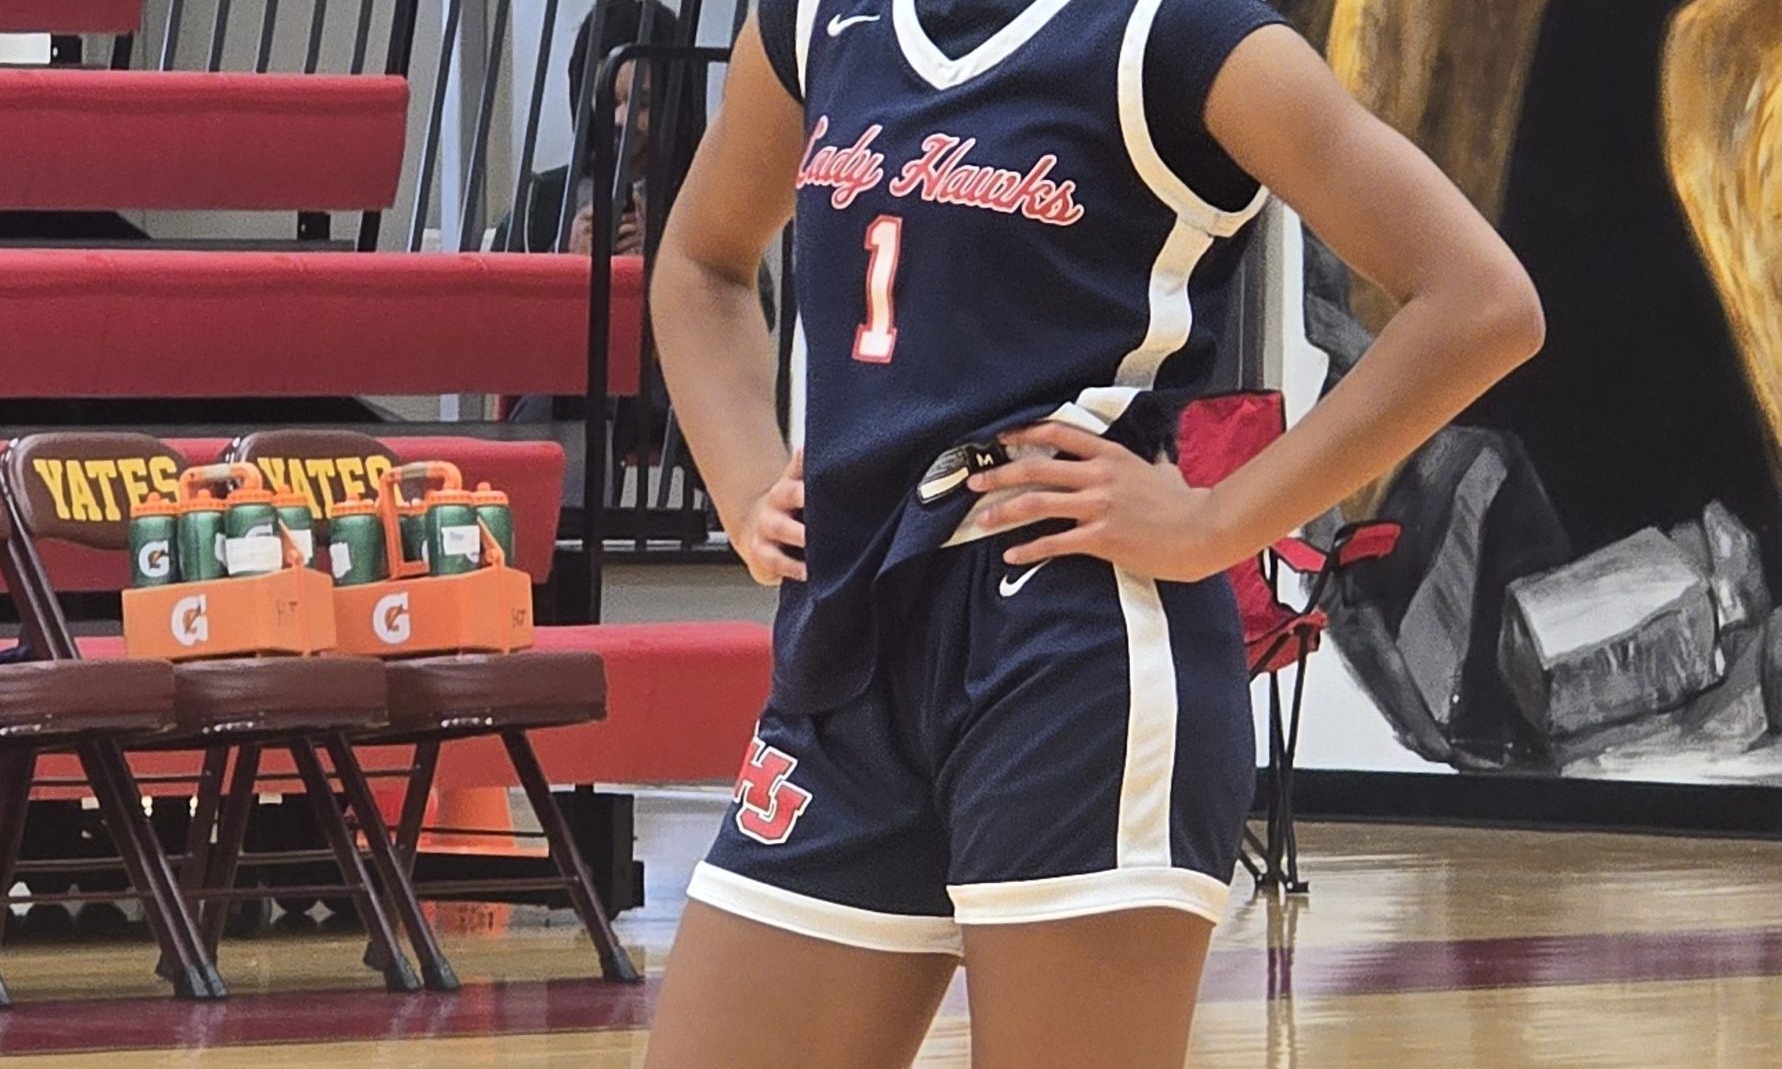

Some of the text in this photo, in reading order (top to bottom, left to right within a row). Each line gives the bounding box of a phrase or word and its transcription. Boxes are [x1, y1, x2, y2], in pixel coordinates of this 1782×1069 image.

[795, 115, 1085, 226] Lady Hawks
[852, 214, 903, 364] 1
[33, 456, 180, 521] YATES
[138, 540, 170, 577] G
[171, 594, 209, 646] G
[372, 592, 411, 644] G
